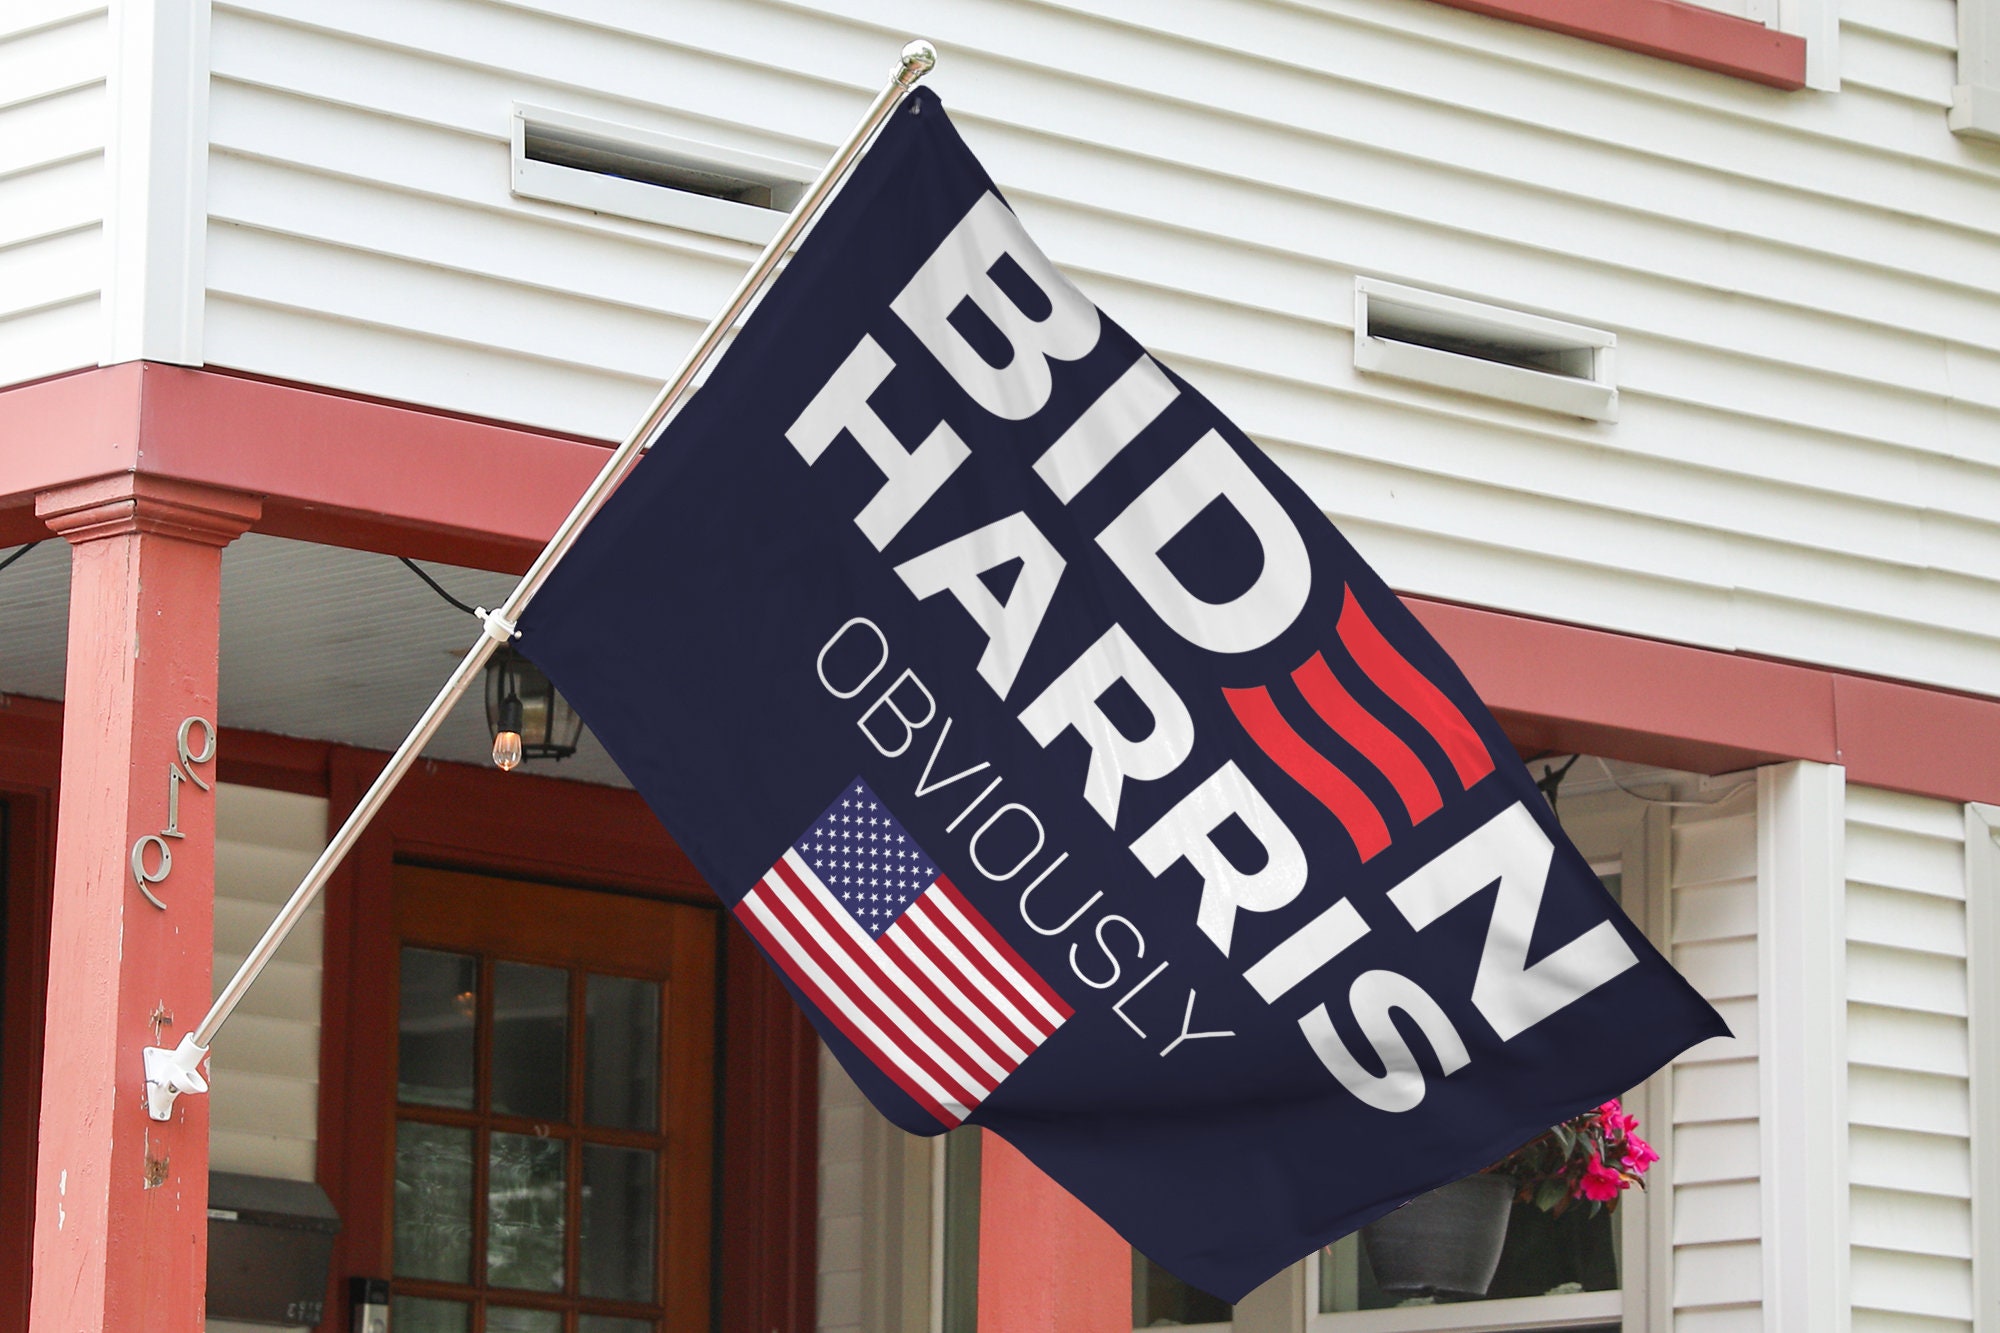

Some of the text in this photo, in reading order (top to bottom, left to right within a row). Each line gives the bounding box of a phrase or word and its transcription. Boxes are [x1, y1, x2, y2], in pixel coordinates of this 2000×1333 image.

[785, 333, 1472, 1113] HARRIS
[816, 616, 1236, 1057] OBVIOUSLY
[889, 190, 1640, 1043] BIDEN
